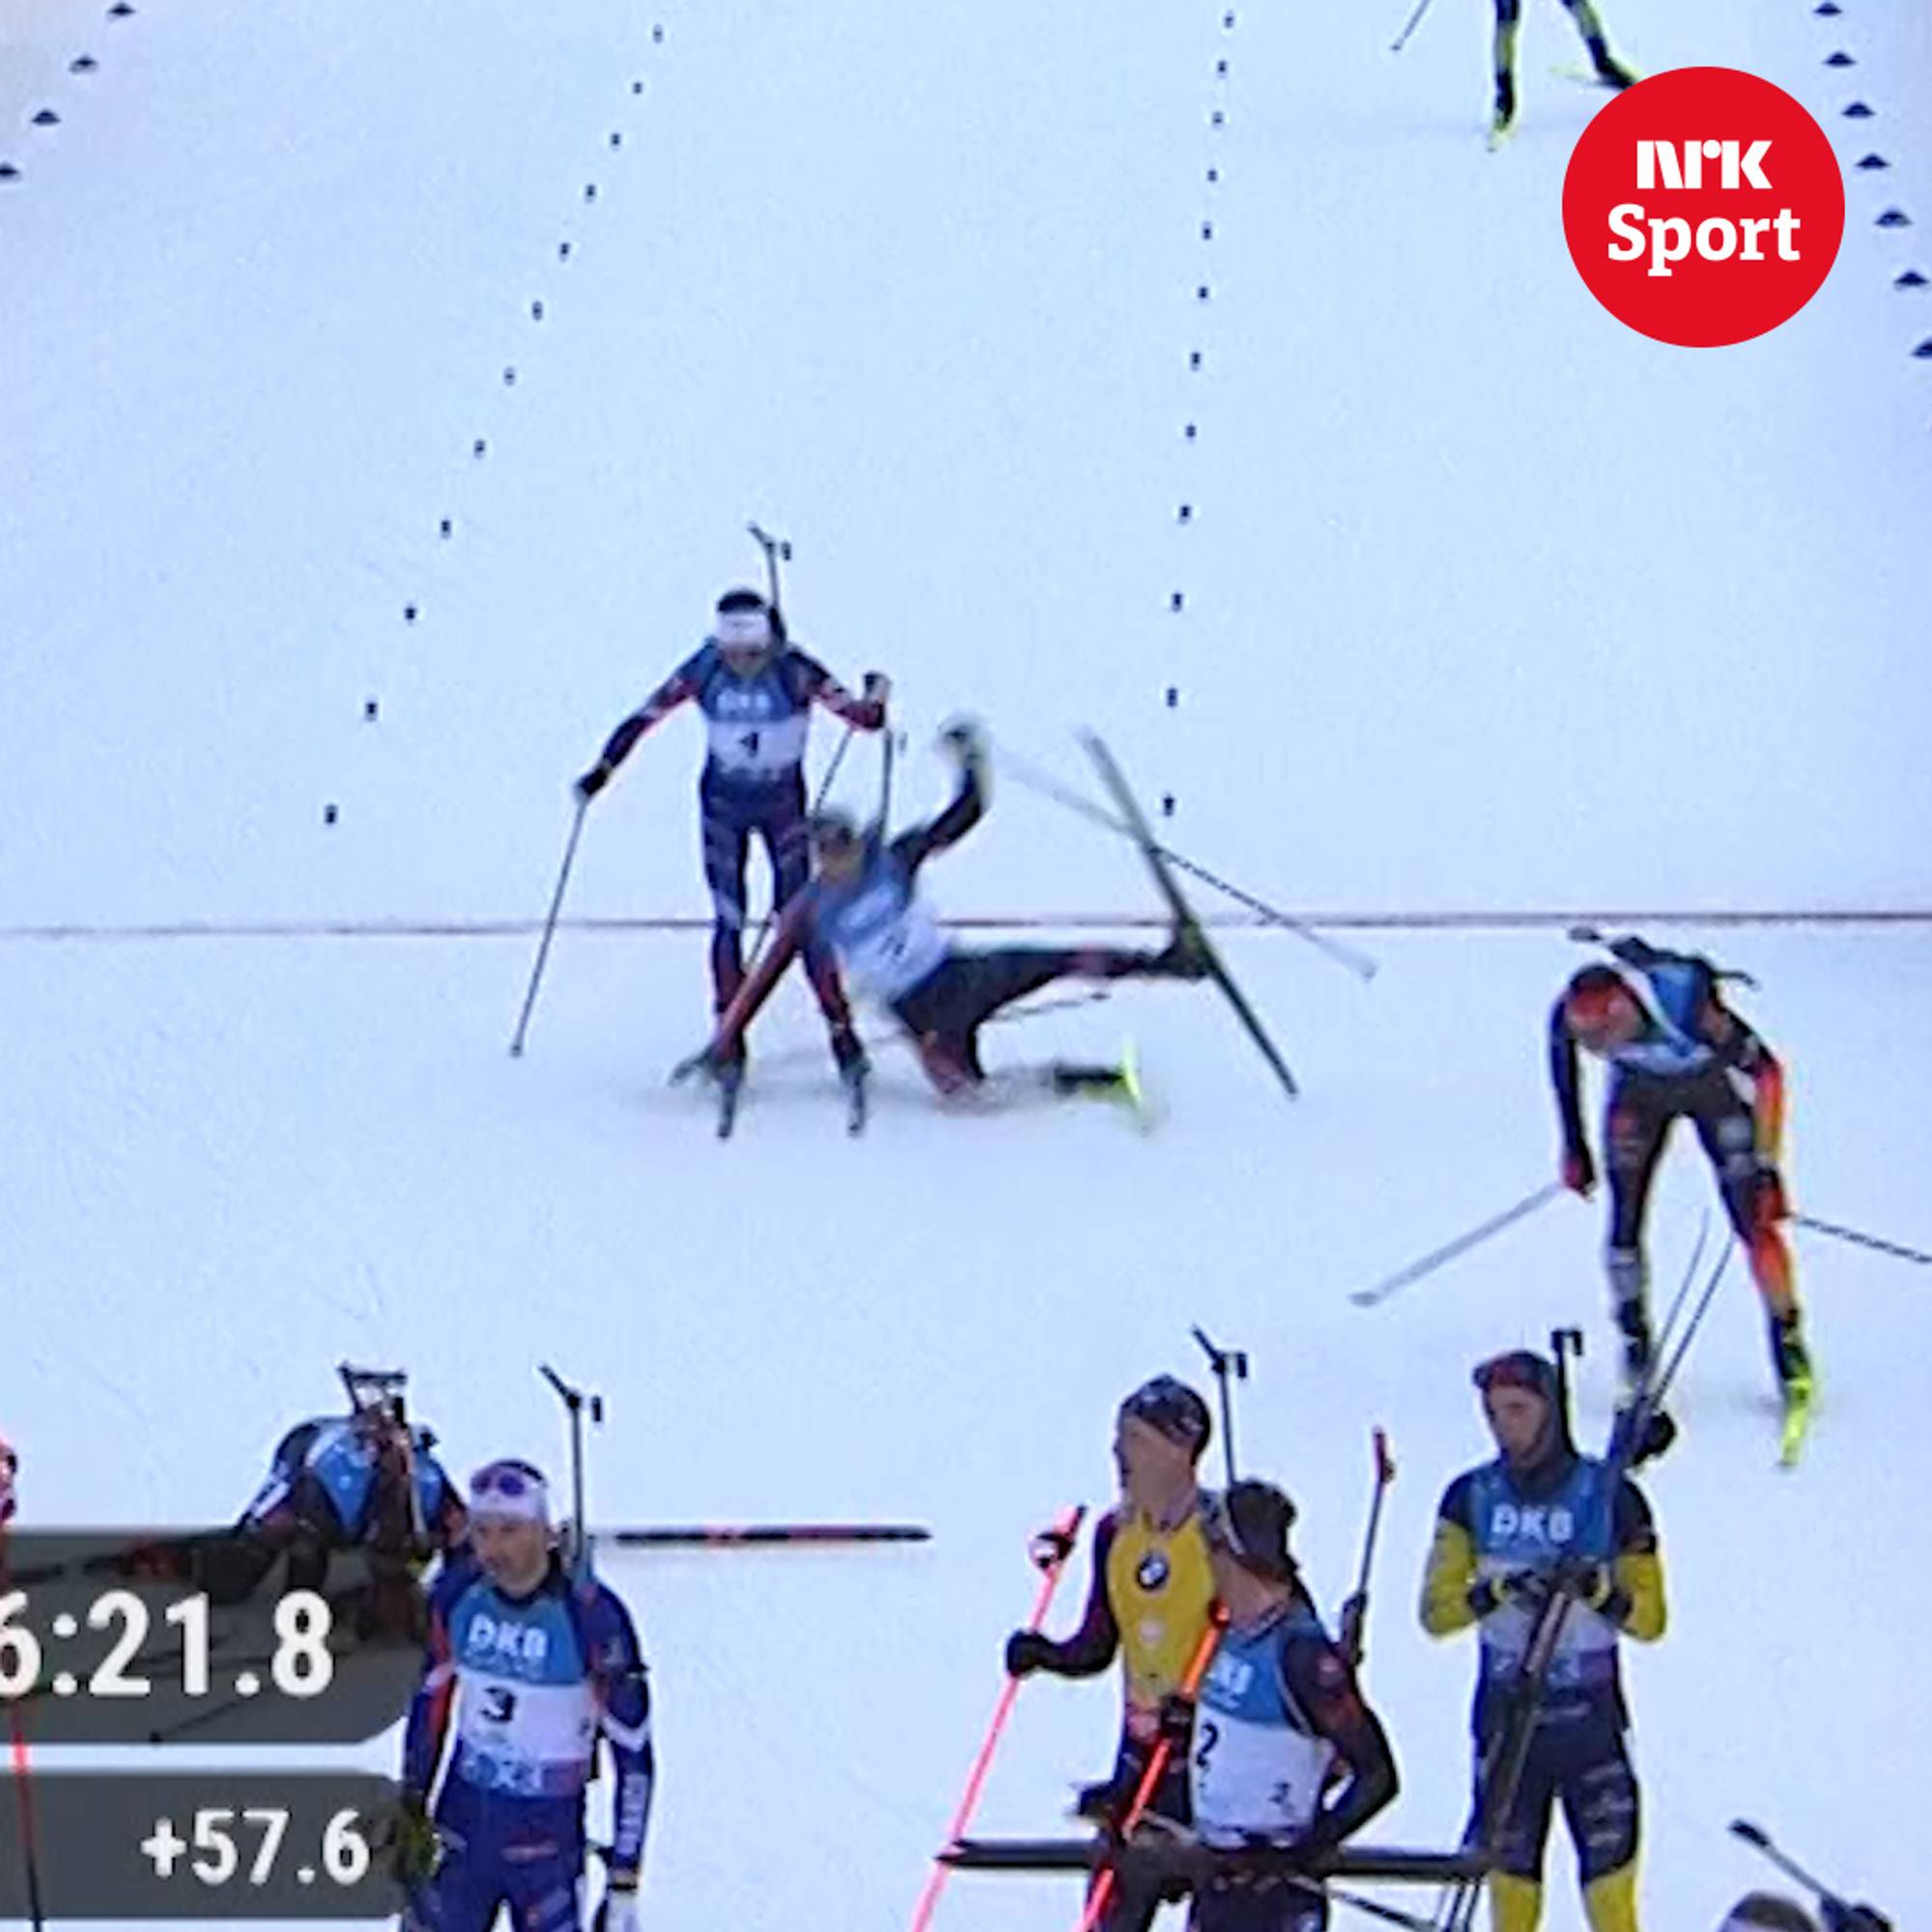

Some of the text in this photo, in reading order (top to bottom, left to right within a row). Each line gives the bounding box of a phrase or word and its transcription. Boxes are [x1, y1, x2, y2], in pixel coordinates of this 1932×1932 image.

[1492, 1503, 1574, 1544] DKB
[480, 1686, 517, 1723] 3
[1196, 1723, 1219, 1767] 2
